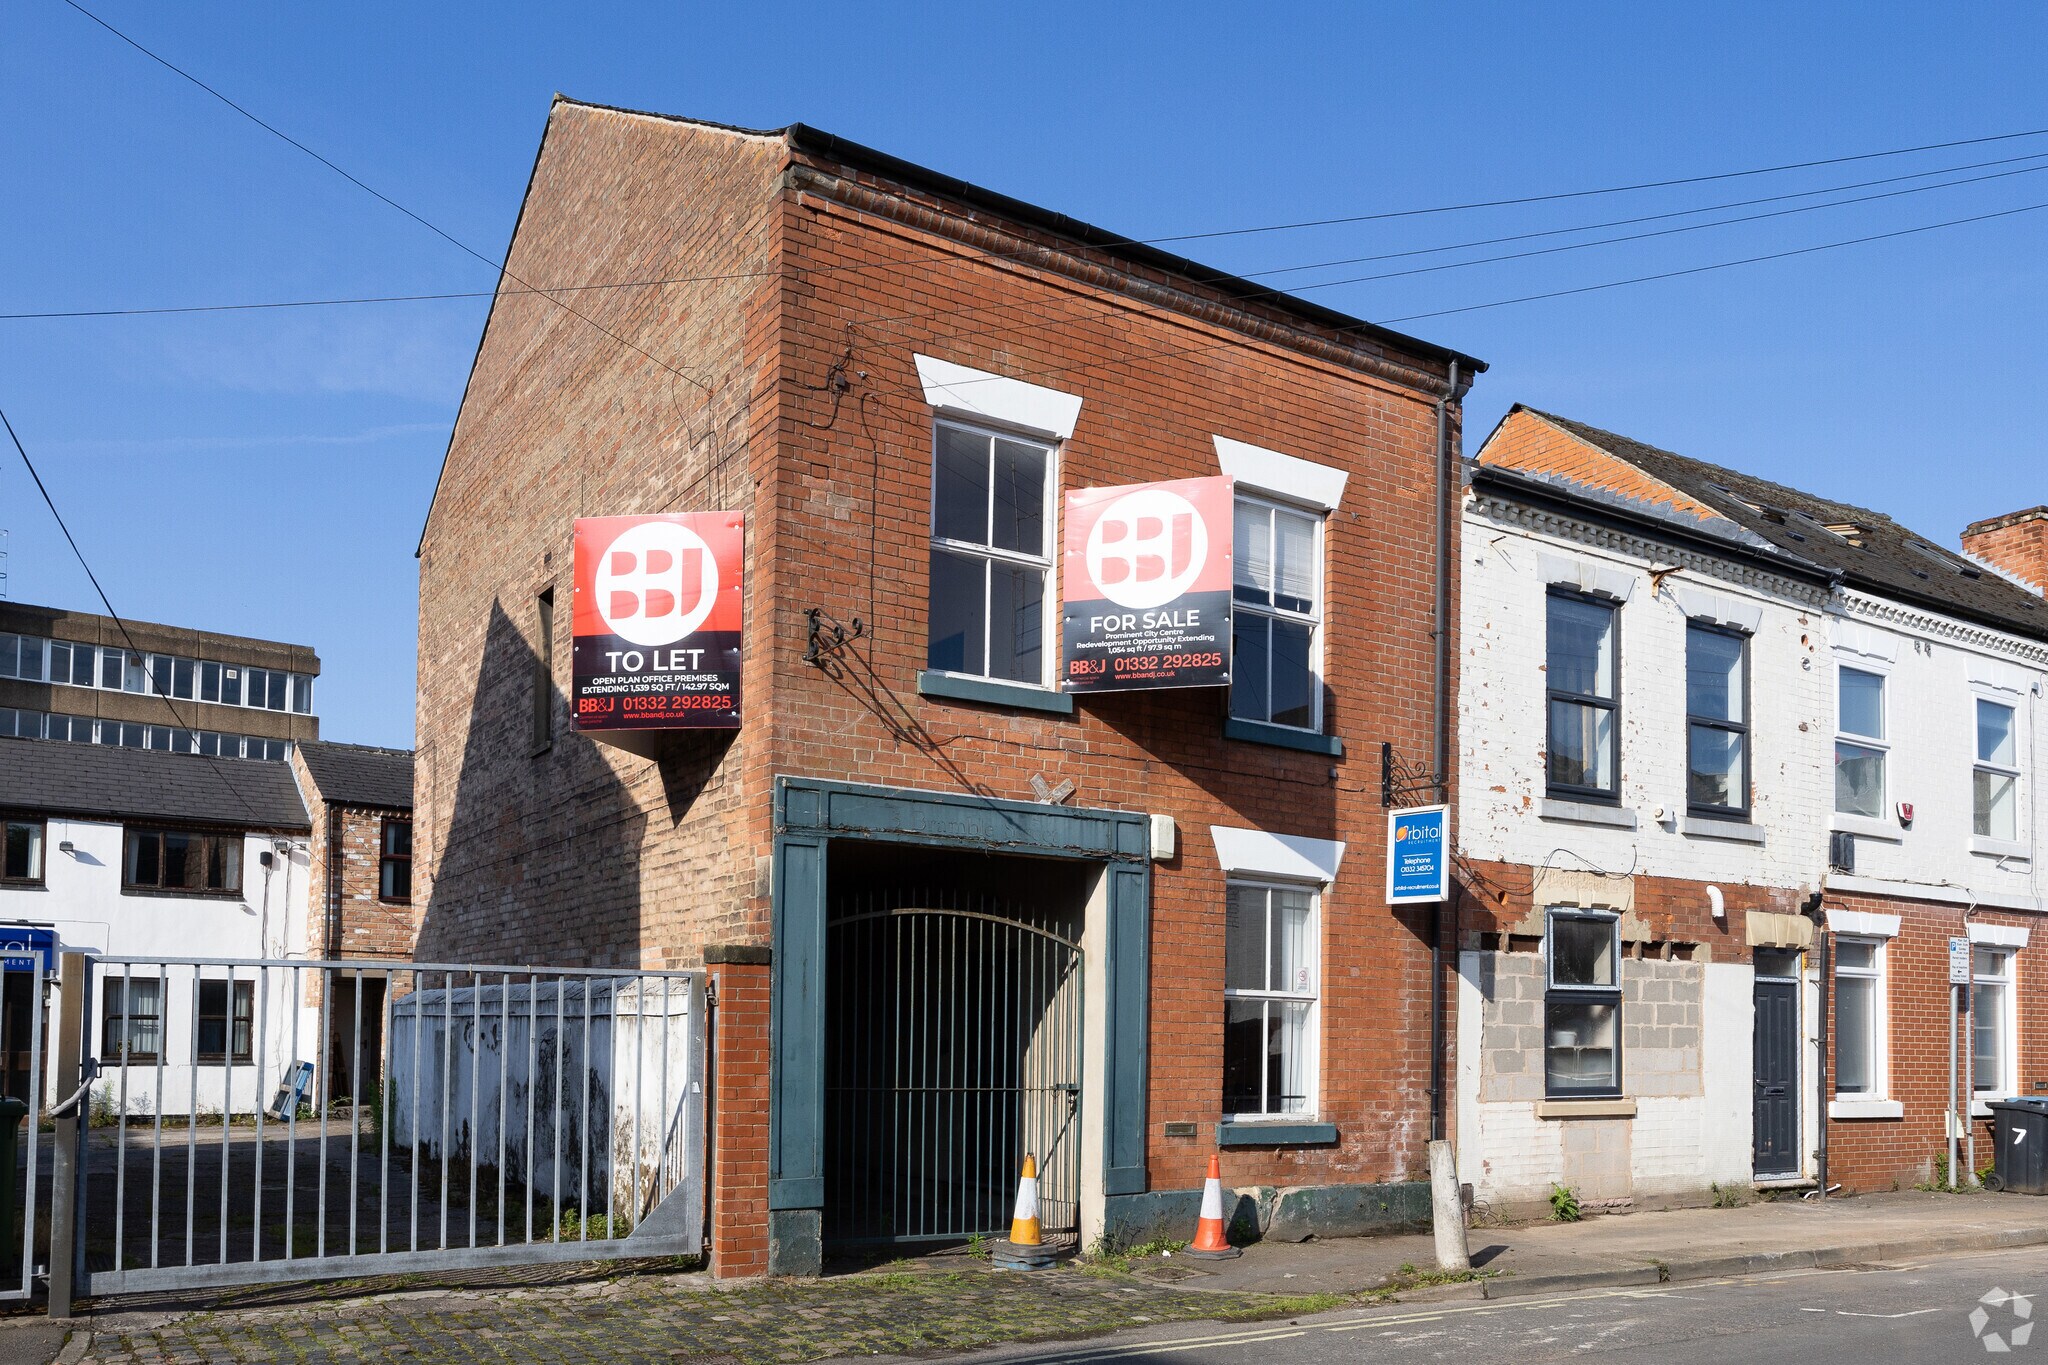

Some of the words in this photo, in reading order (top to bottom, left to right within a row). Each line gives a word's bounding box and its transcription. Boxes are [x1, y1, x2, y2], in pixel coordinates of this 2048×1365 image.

[1091, 614, 1136, 633] FOR
[1142, 609, 1200, 630] SALE
[1076, 639, 1132, 649] Redevelopment
[1132, 636, 1177, 645] Opportunity
[1177, 633, 1215, 642] Extending
[1105, 631, 1143, 640] Prominent
[1144, 629, 1159, 638] City
[1108, 647, 1126, 655] 1,054
[1126, 646, 1136, 654] sq
[1136, 644, 1142, 652] ft
[1143, 644, 1147, 652] /
[605, 650, 644, 672] TO
[653, 649, 705, 671] LET
[1070, 658, 1106, 675] BB&J
[1114, 655, 1159, 672] 01332
[1163, 653, 1222, 668] 292825
[592, 677, 616, 685] OPEN
[617, 676, 640, 684] PLAN
[641, 675, 673, 683] OFFICE
[674, 674, 718, 682] PREMISES
[1114, 670, 1176, 679] www.bbandj.co.uk
[582, 685, 629, 694] EXTENDING
[630, 684, 650, 693] 1,539
[650, 683, 664, 692] SQ
[665, 683, 676, 691] FT
[676, 682, 682, 691] /
[682, 682, 707, 691] 142.97
[709, 682, 730, 691] SQM
[579, 697, 615, 713] BB&J
[623, 696, 667, 711] 01332
[671, 695, 731, 709] 292825
[623, 710, 685, 719] www.bbandj.co.uk
[1396, 822, 1441, 842] Orbital
[2012, 1127, 2027, 1144] 7
